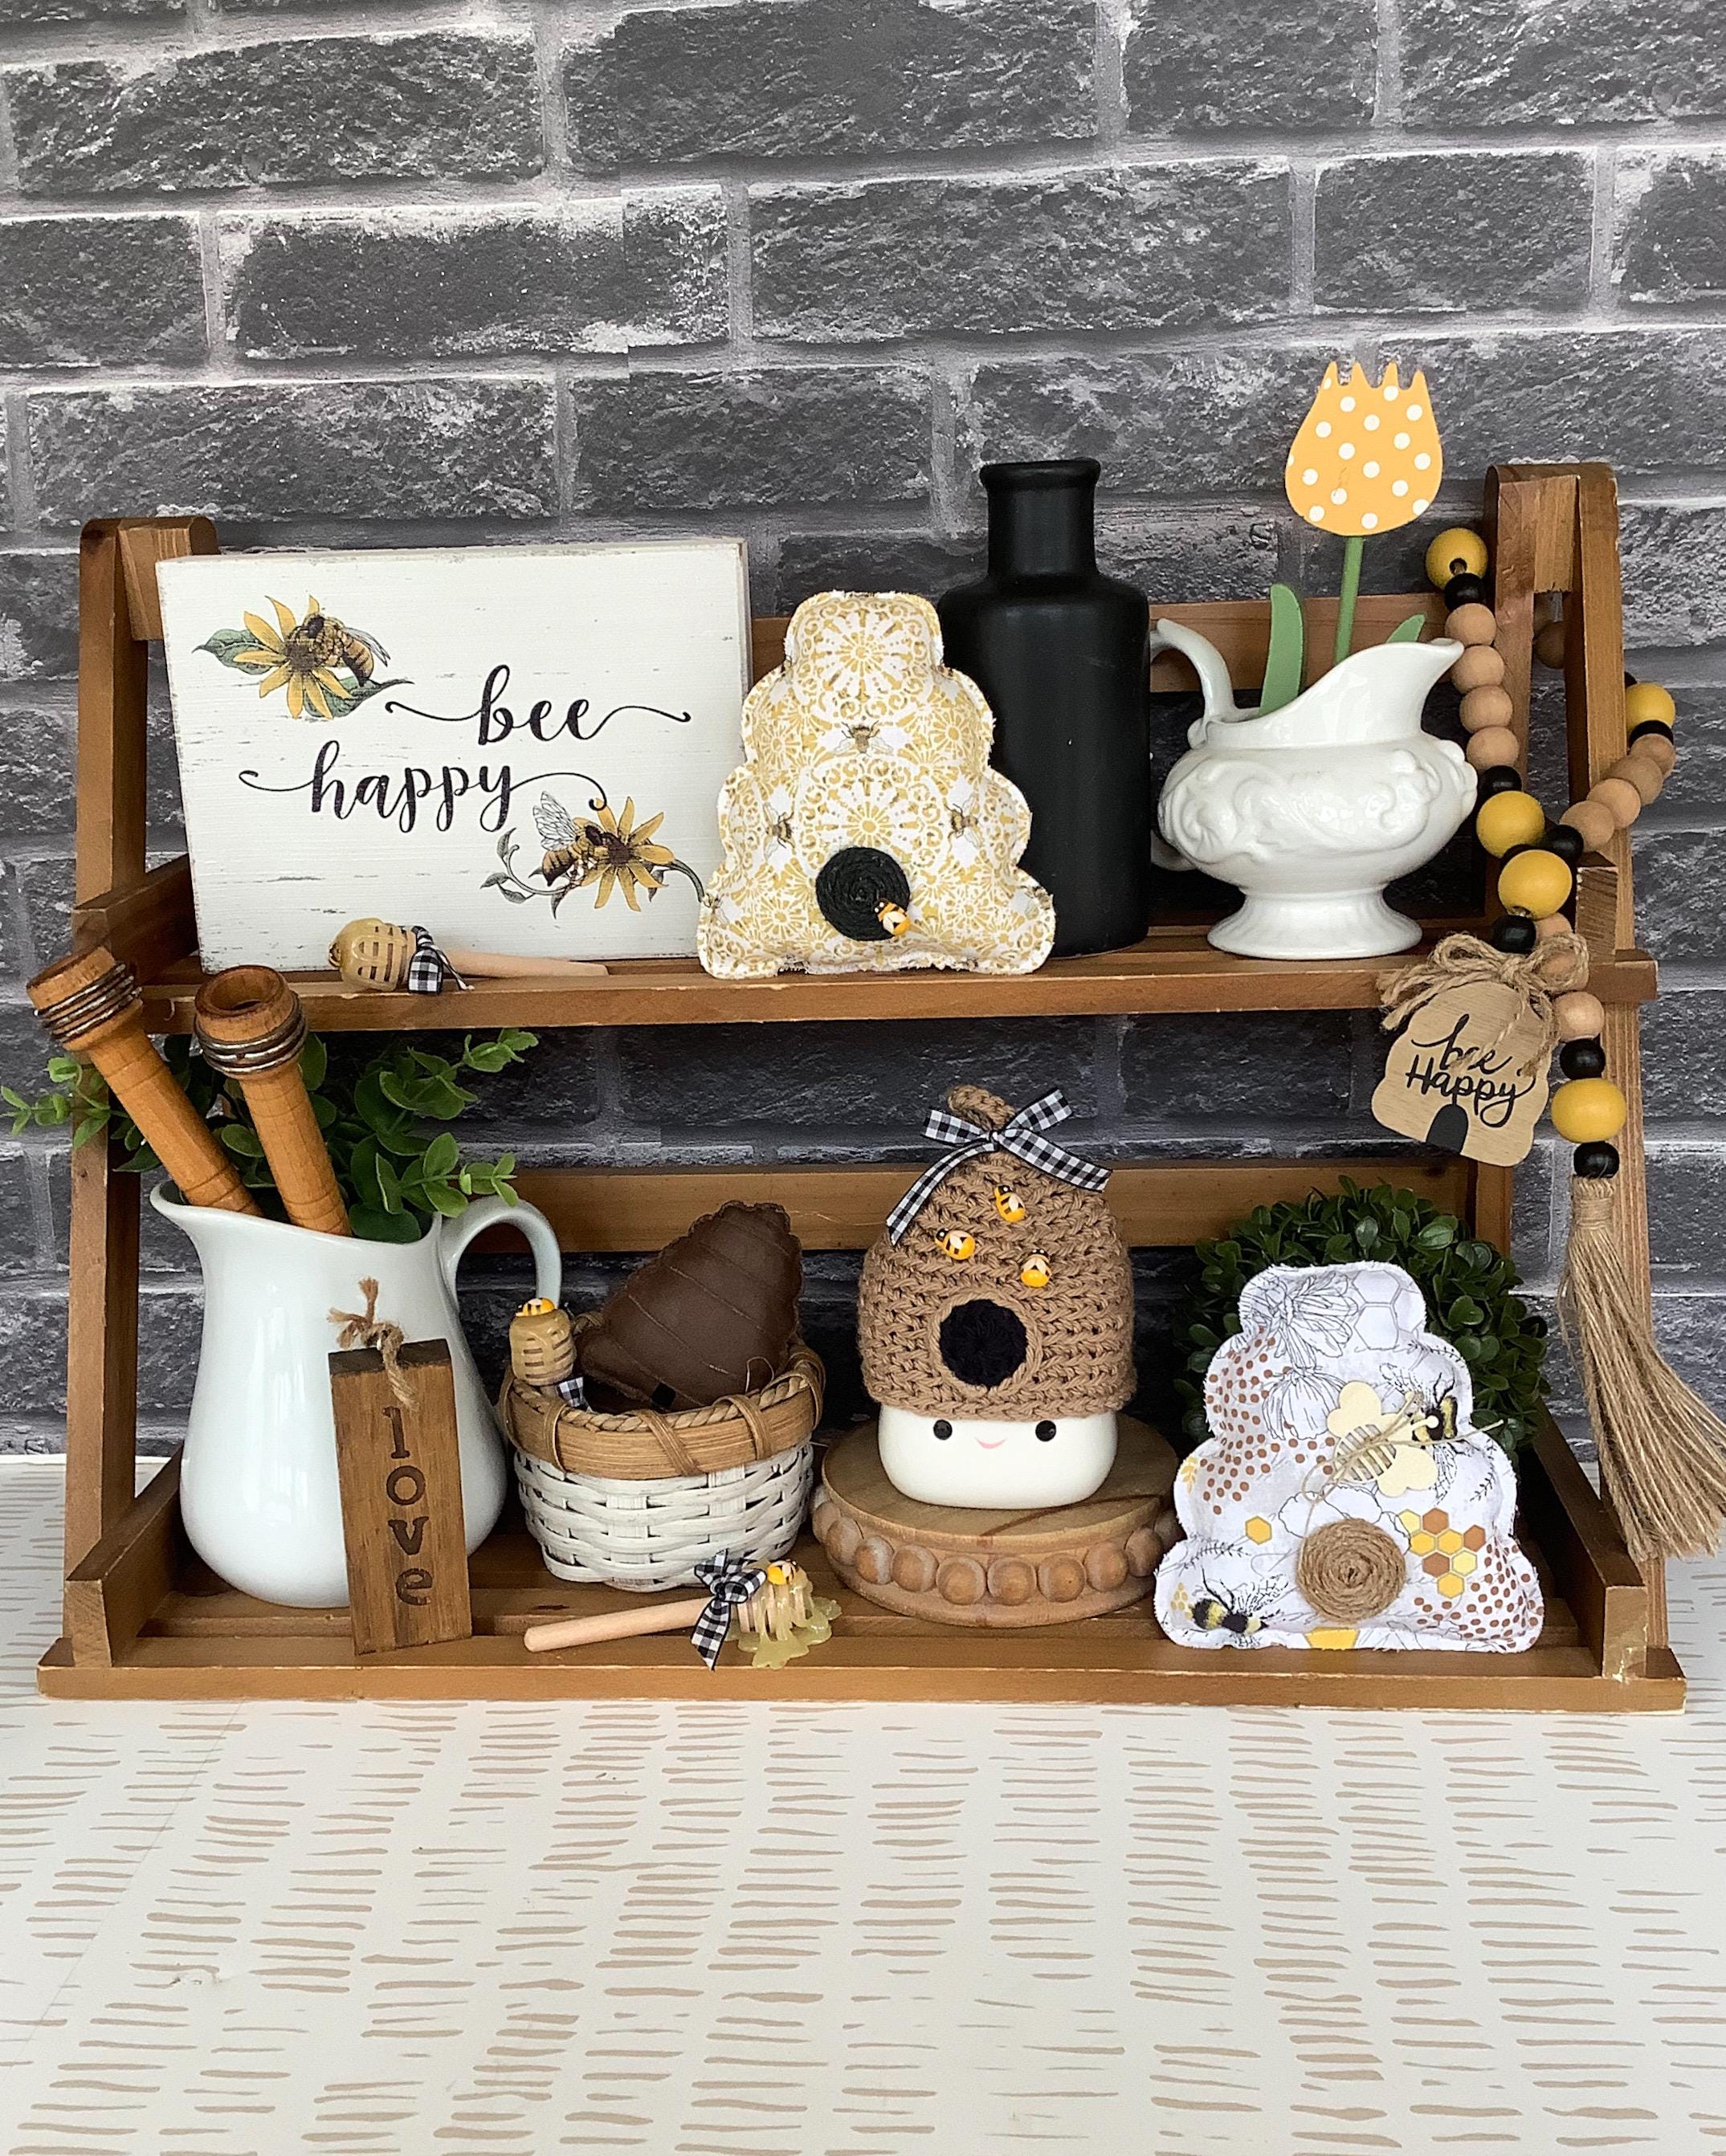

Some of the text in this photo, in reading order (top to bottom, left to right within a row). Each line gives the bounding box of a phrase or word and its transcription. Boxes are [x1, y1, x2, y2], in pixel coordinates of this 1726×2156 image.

[386, 665, 692, 746] bee
[239, 740, 607, 833] happy
[1406, 1054, 1536, 1128] Happy
[382, 1406, 433, 1605] love
